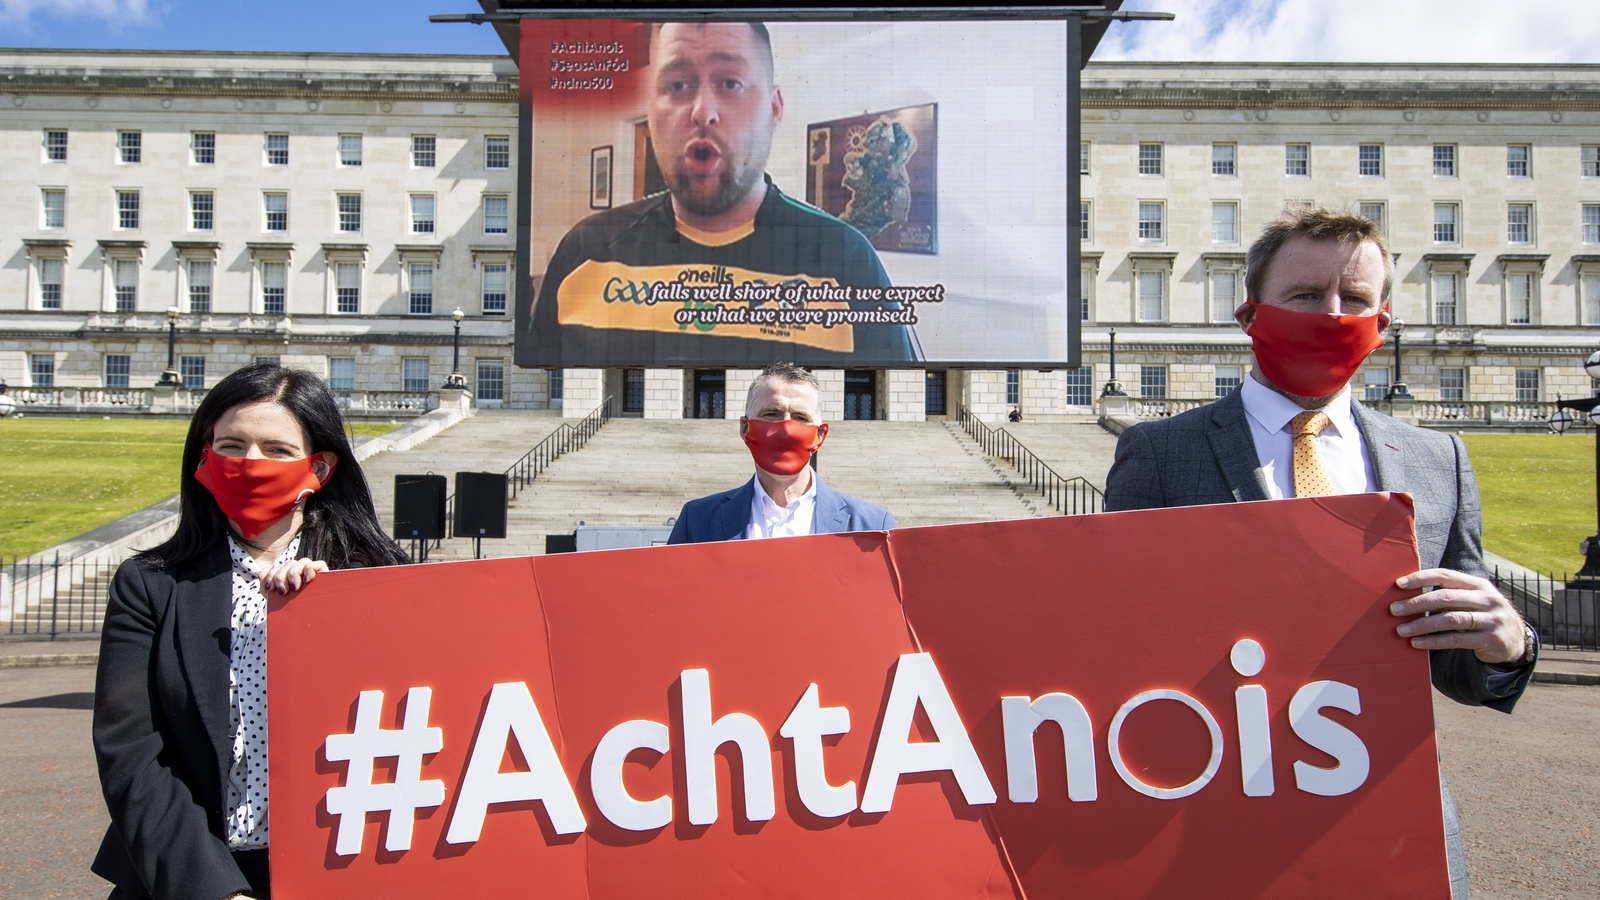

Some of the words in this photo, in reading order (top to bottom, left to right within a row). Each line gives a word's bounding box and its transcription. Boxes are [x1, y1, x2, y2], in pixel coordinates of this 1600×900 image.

[550, 41, 624, 54] #AchtAnois
[550, 57, 629, 72] #SeasAnFód
[550, 77, 614, 90] #ndna500
[648, 283, 690, 303] falls
[693, 283, 731, 300] well
[734, 283, 781, 300] short
[785, 284, 807, 304] of
[807, 284, 852, 300] what
[856, 288, 882, 300] we
[885, 285, 945, 304] expect
[676, 310, 697, 322] or
[700, 306, 749, 322] what
[750, 310, 776, 322] we
[780, 310, 823, 322] were
[825, 306, 916, 326] promised.
[325, 638, 1371, 856] #AchtAnois
